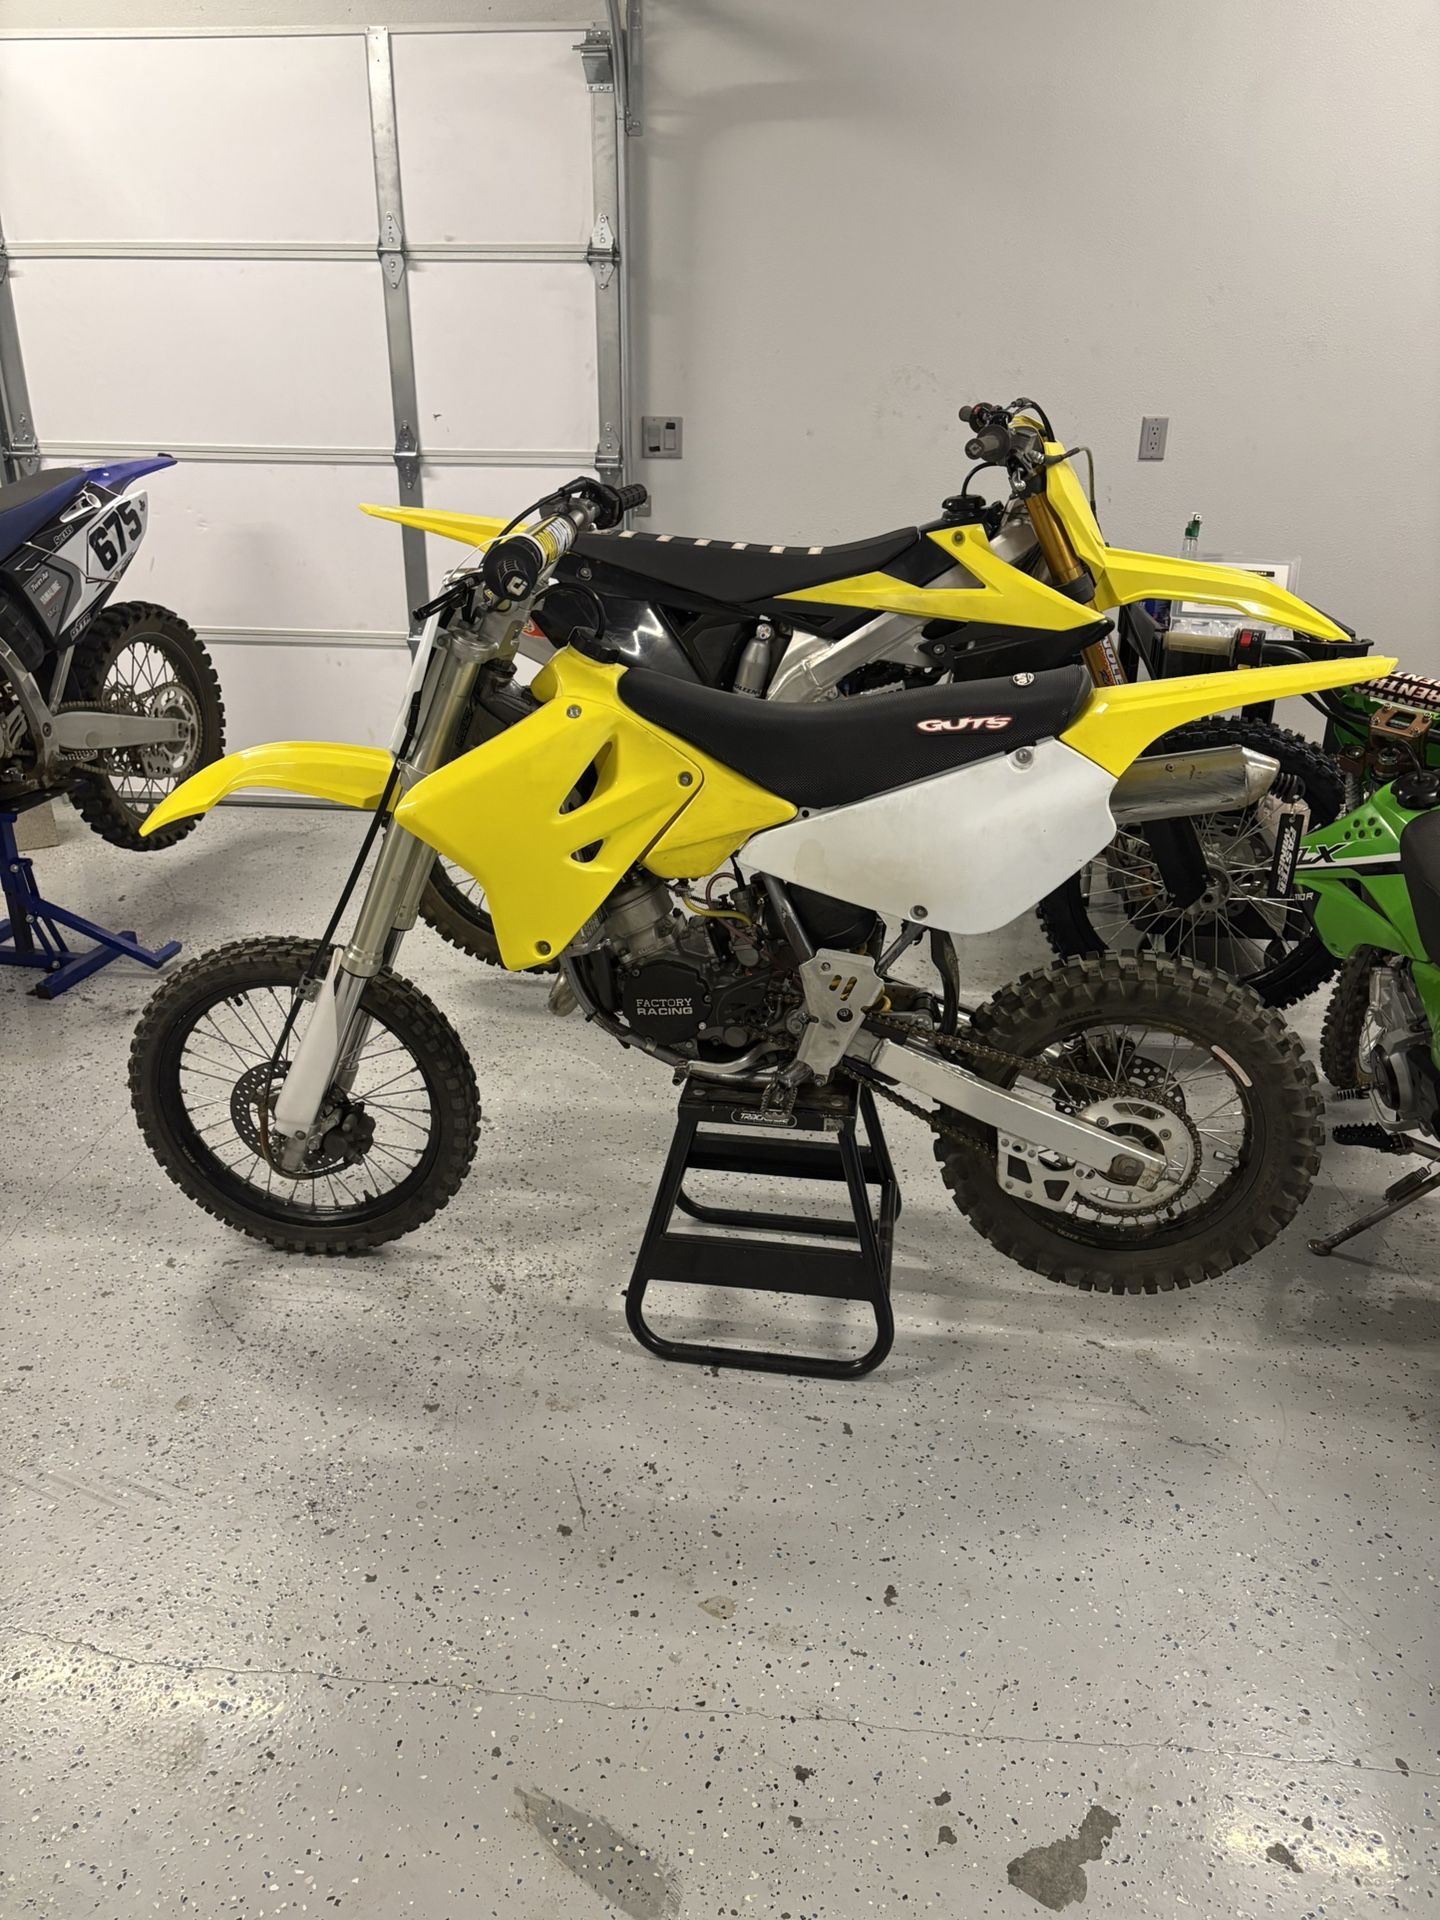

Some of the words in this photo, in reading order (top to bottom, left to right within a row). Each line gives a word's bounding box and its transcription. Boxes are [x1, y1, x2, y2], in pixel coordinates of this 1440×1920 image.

[89, 501, 142, 571] 675
[1390, 671, 1440, 688] ENT
[1360, 678, 1440, 703] RENTH
[917, 714, 1014, 733] GUTS
[1297, 843, 1349, 865] LX
[636, 998, 692, 1008] FACTORY
[637, 1007, 693, 1016] RACING
